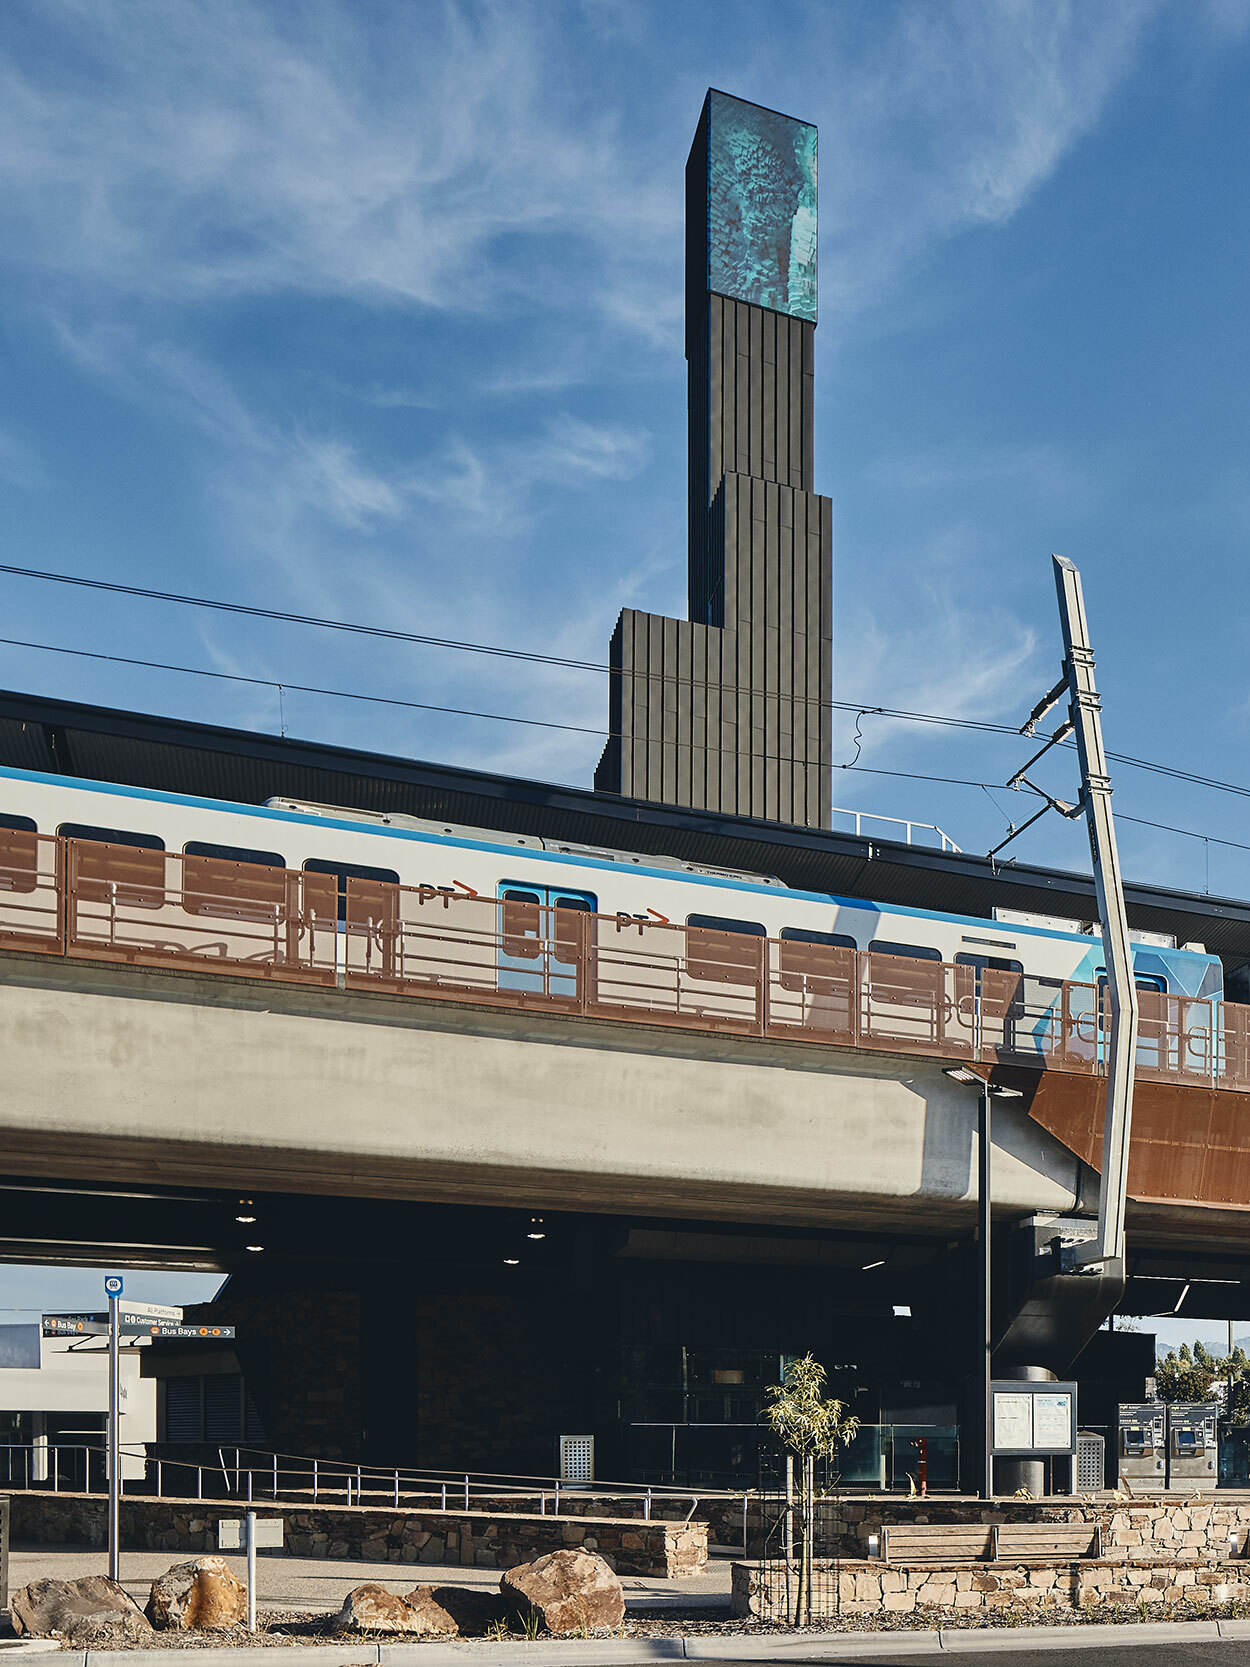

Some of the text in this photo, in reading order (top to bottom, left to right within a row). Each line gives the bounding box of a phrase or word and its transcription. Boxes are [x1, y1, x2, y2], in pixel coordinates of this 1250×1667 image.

[57, 1320, 66, 1328] Bus
[67, 1321, 77, 1331] Bay
[136, 1317, 174, 1327] Customer Service
[162, 1327, 176, 1335] Bus
[178, 1327, 197, 1336] Bays
